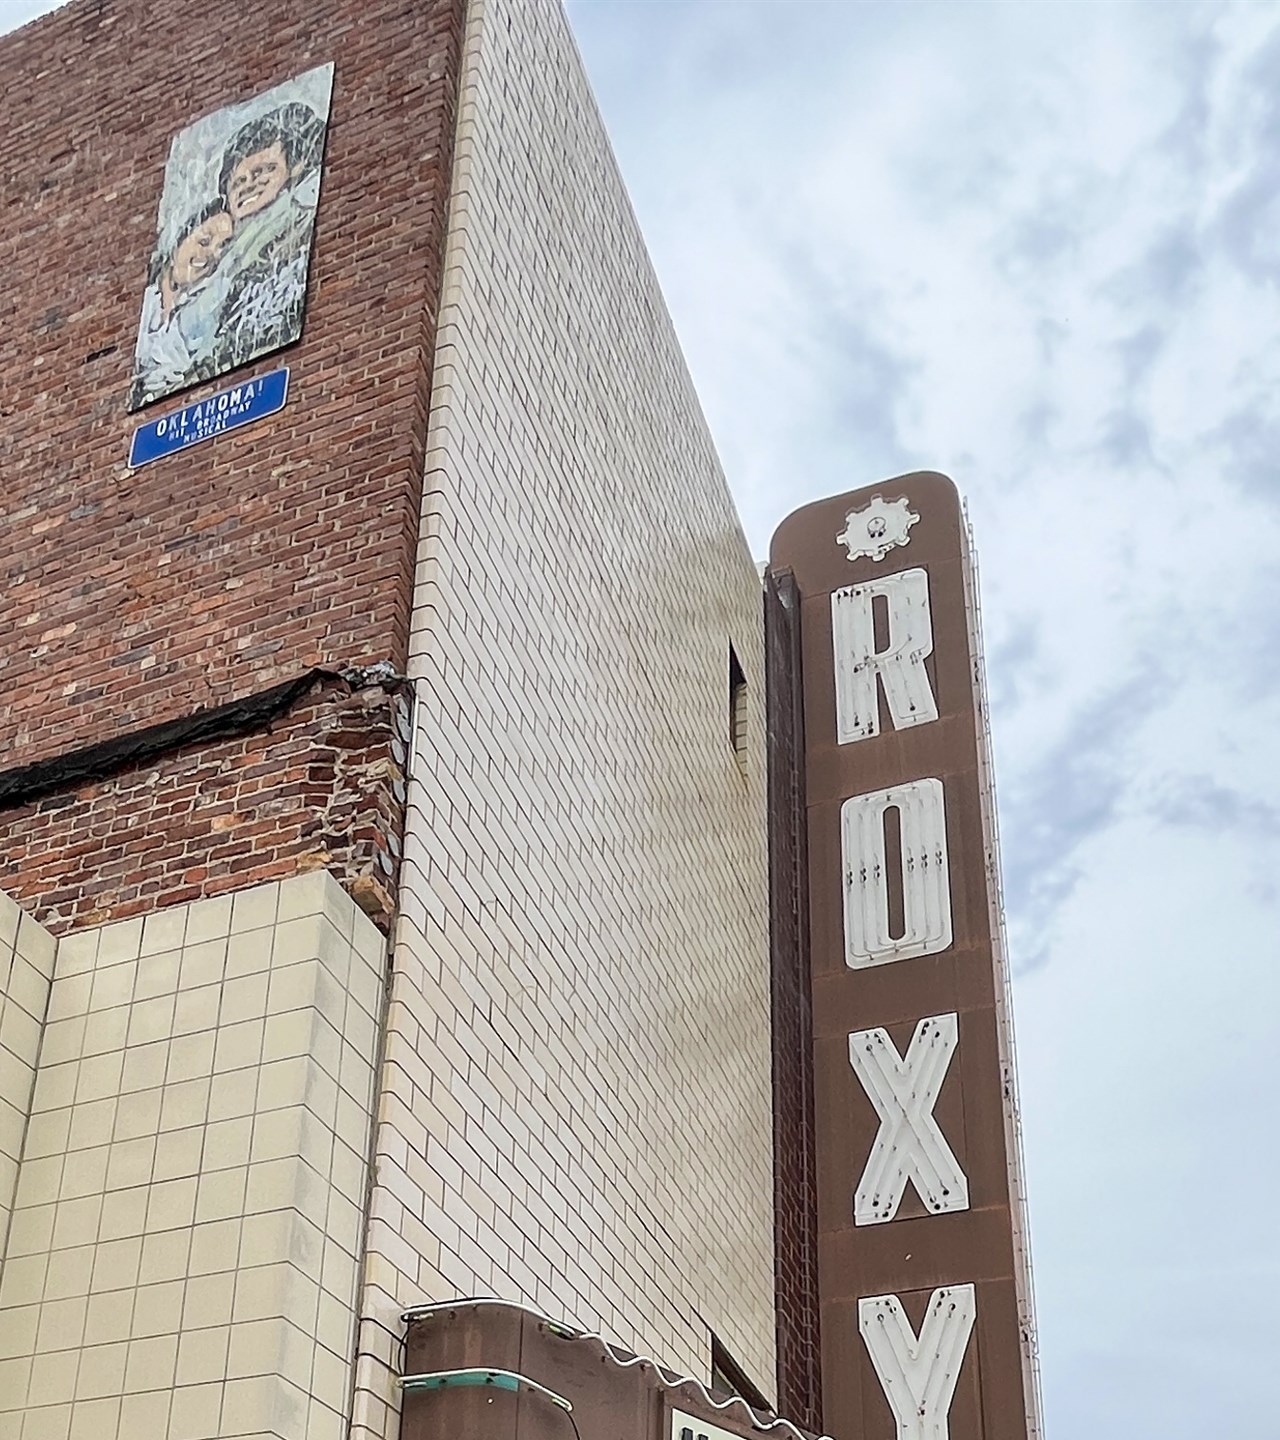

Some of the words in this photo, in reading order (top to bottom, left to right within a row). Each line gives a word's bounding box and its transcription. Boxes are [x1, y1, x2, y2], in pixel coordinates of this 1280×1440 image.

[157, 380, 264, 436] OKLAHOMA!
[197, 401, 252, 429] BROADWAY
[184, 420, 227, 443] MUSICAL
